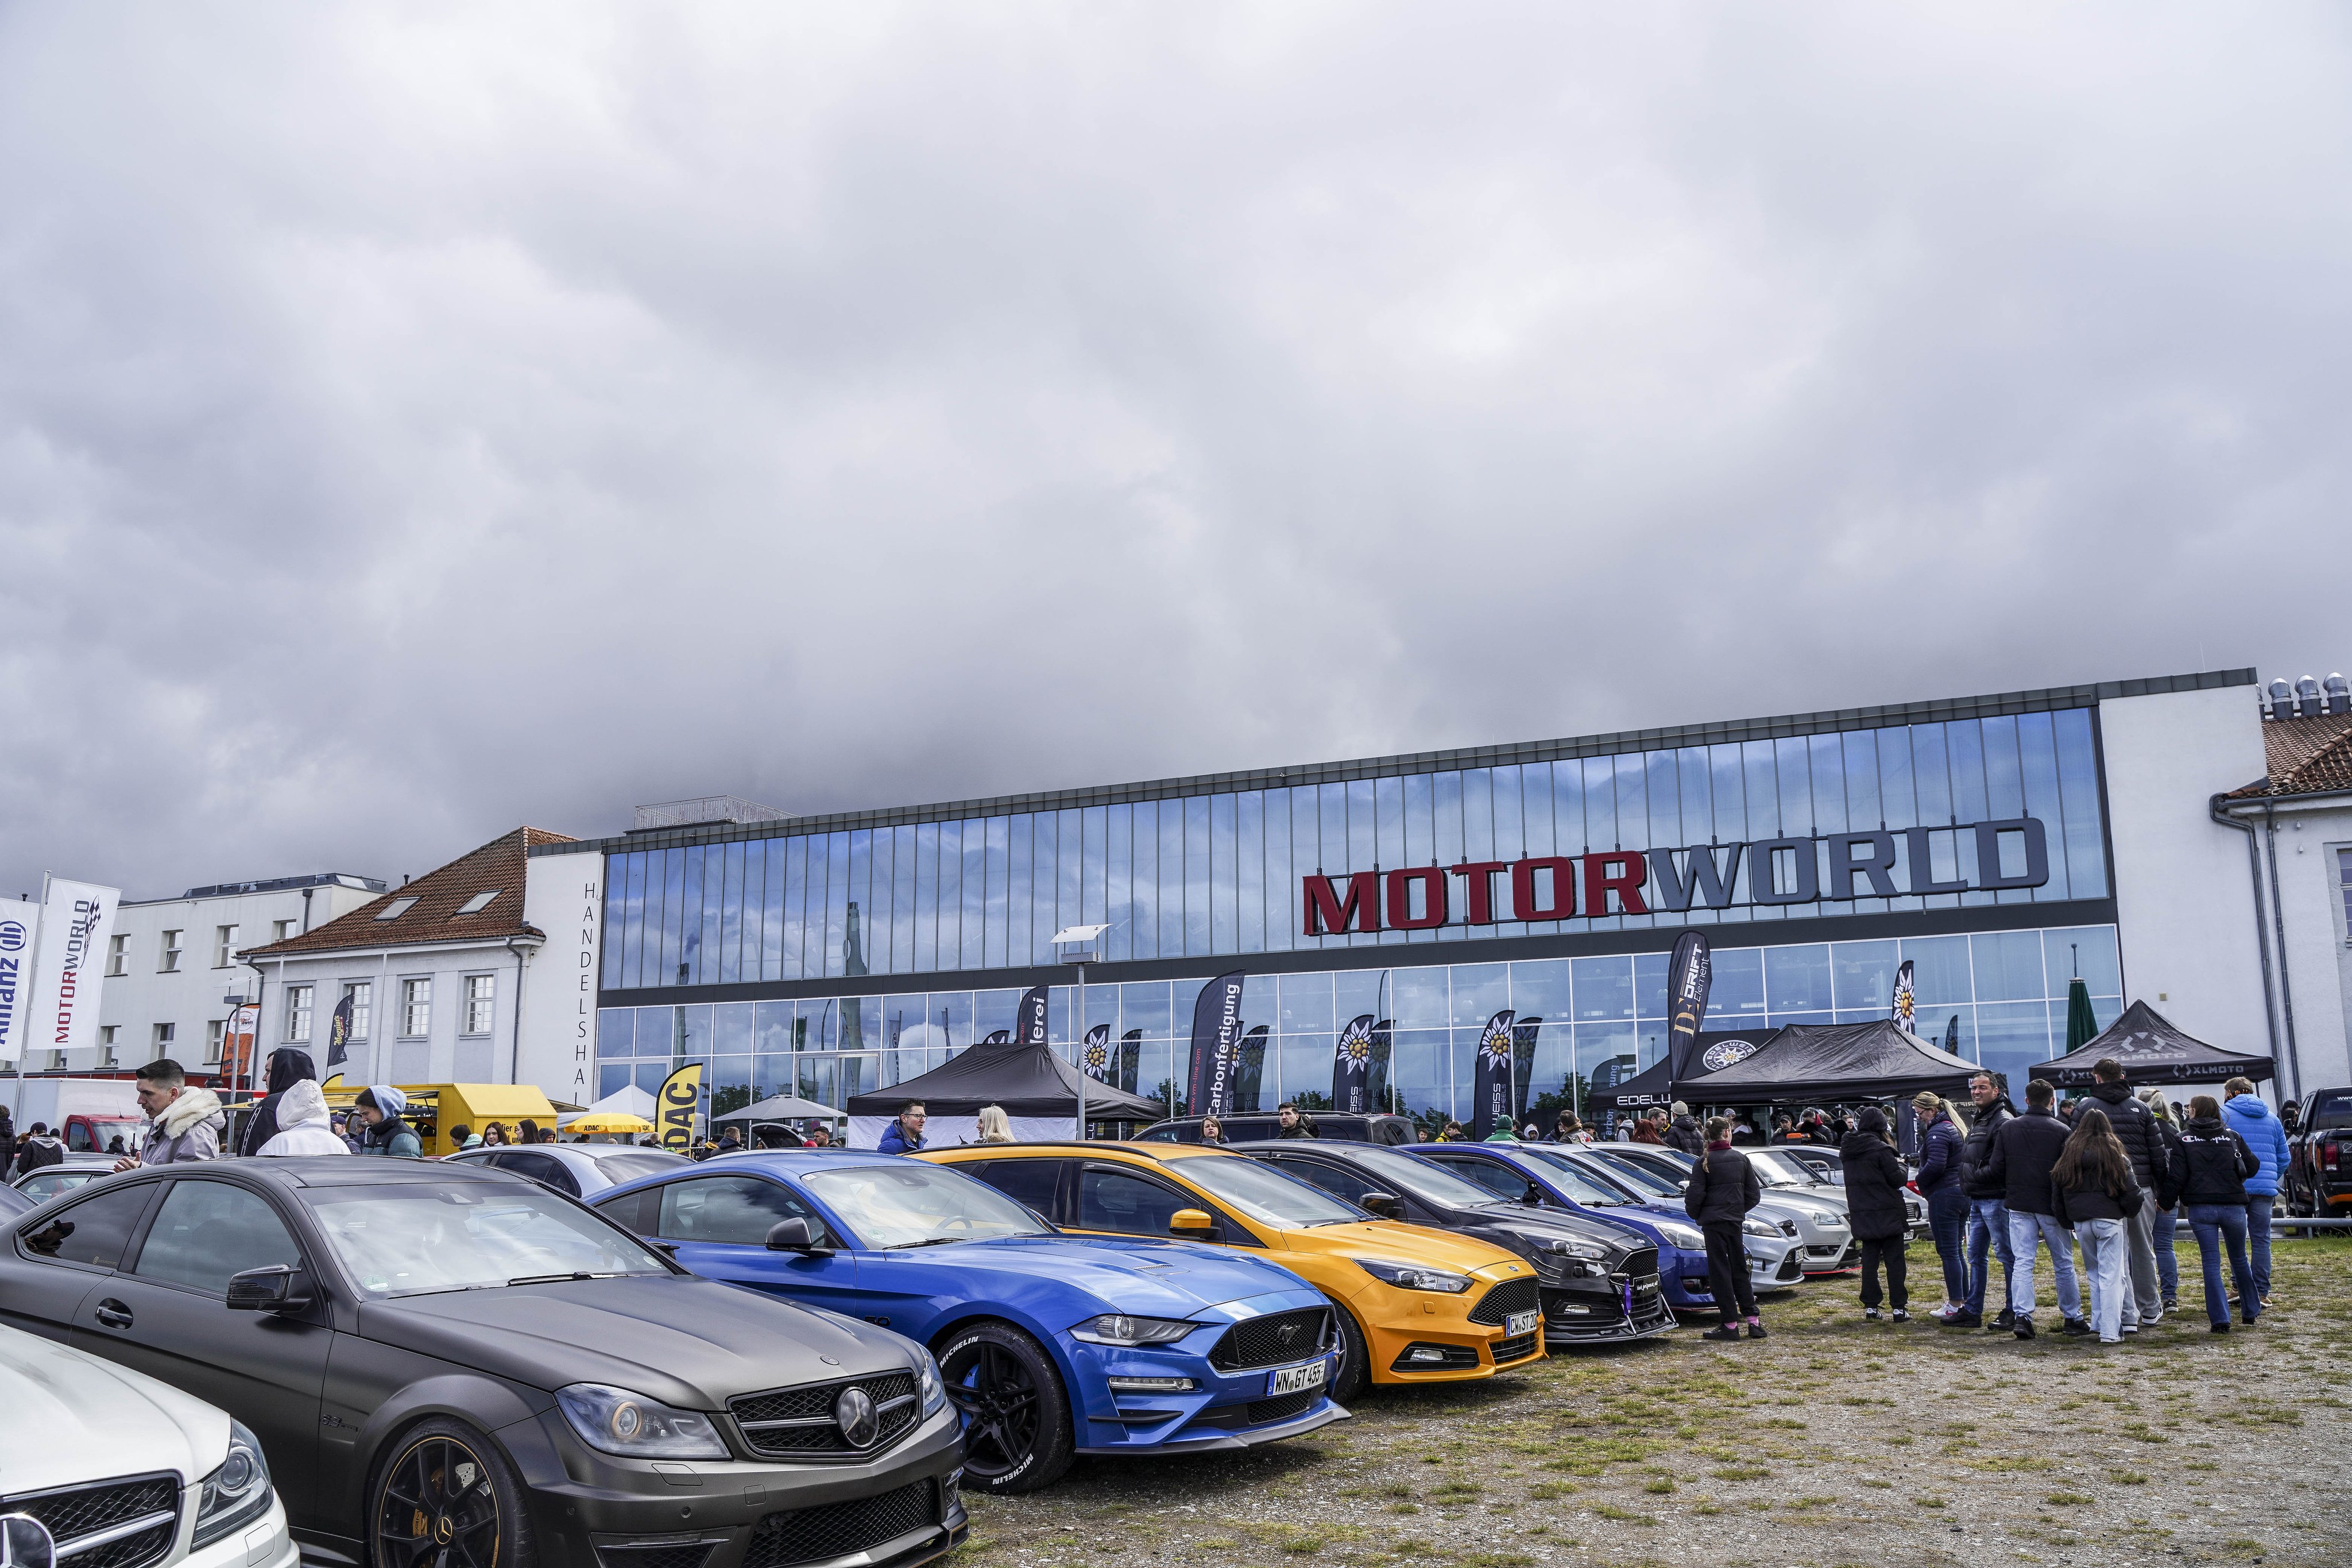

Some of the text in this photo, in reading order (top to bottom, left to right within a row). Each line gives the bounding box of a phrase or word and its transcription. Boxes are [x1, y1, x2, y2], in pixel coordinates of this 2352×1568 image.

[1302, 817, 2049, 936] MOTORWORLD
[55, 900, 90, 1043] MOTORWORLD
[1684, 943, 1702, 999] DRIFT
[1693, 957, 1709, 1002] Element
[1707, 1042, 1754, 1060] EDELWEIS
[2193, 1065, 2244, 1074] XLMOTO
[1190, 1048, 1201, 1116] www.vm-line.com
[663, 1082, 698, 1151] DAC
[1510, 1318, 1519, 1333] CW
[1522, 1314, 1529, 1331] ST
[939, 1335, 979, 1369] MICHELIN
[1275, 1372, 1290, 1392] WN
[1294, 1368, 1307, 1388] GT
[1307, 1364, 1321, 1385] 455
[992, 1453, 1034, 1485] MICHELIN
